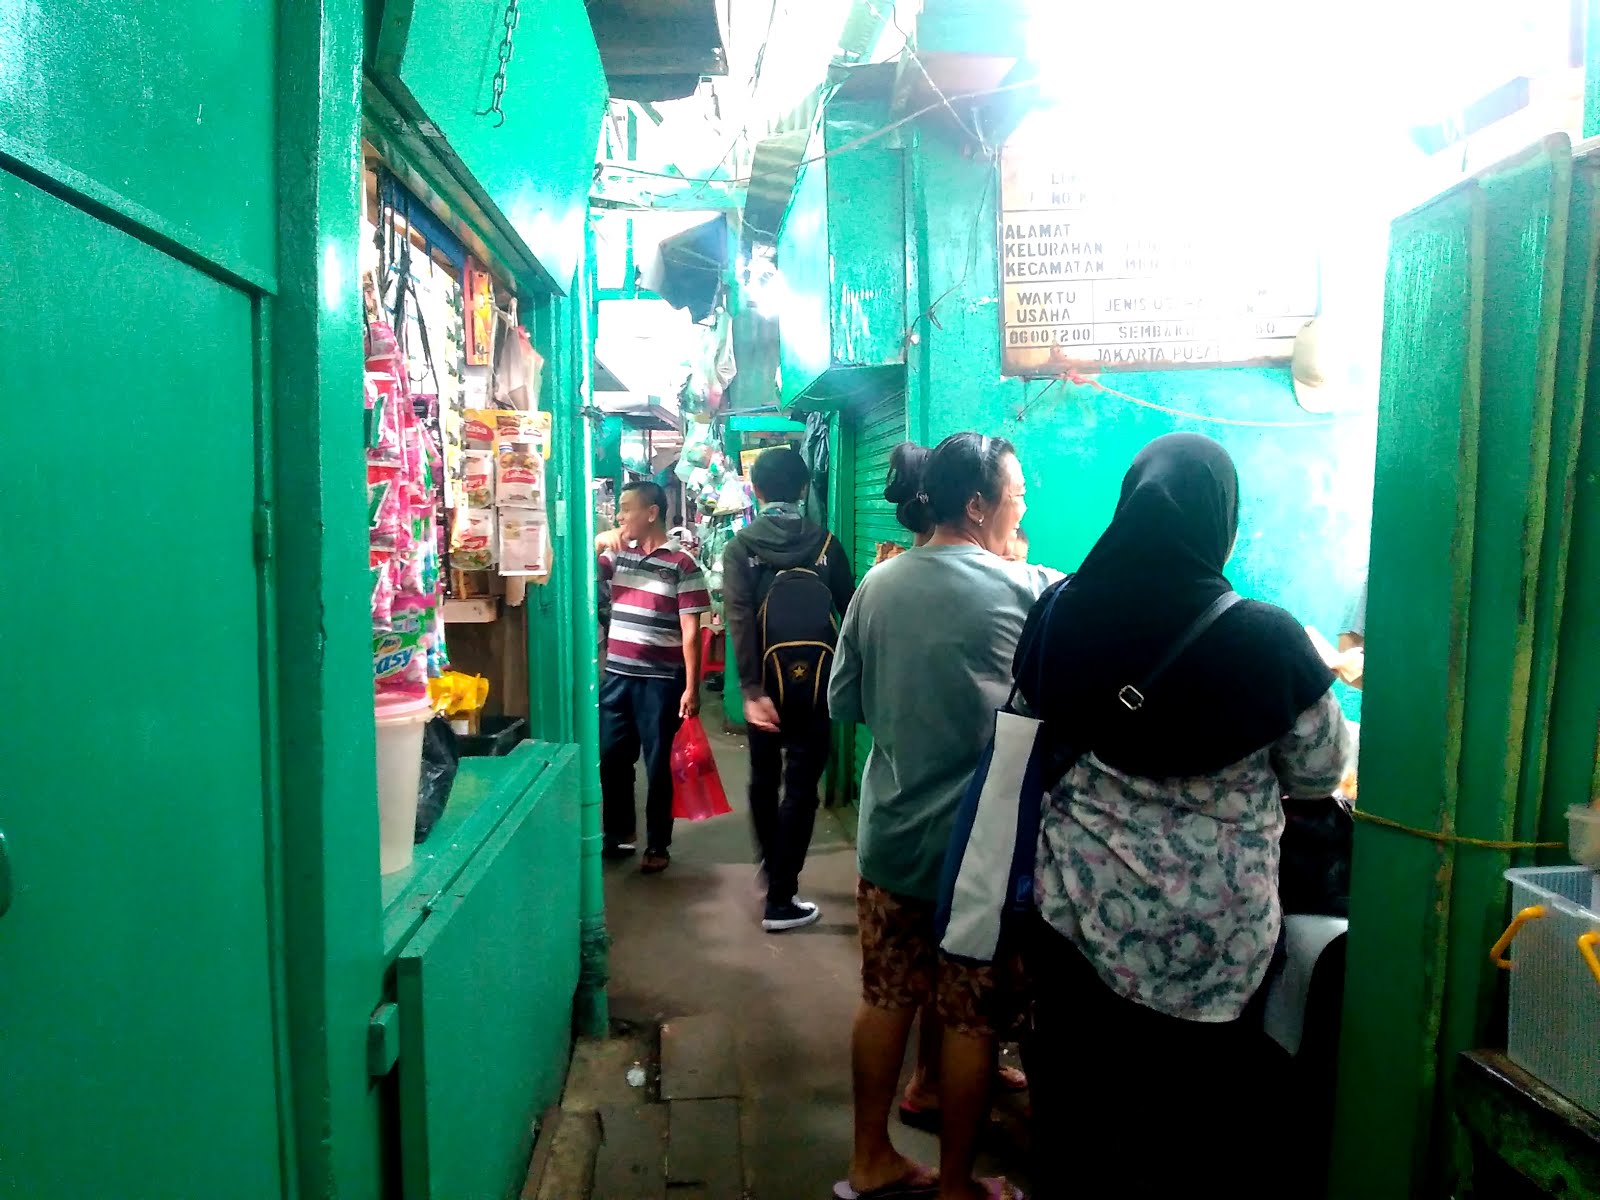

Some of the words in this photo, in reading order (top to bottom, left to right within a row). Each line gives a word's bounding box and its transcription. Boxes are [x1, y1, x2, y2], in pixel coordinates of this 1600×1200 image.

[1004, 223, 1071, 240] ALAMAT
[1004, 242, 1103, 258] KELURAHAN
[1004, 260, 1104, 277] KECAMATAN
[1016, 291, 1076, 305] WAKTU
[1105, 298, 1147, 312] JENIS
[1016, 308, 1071, 323] USAHA
[1093, 347, 1166, 362] JAKARTA
